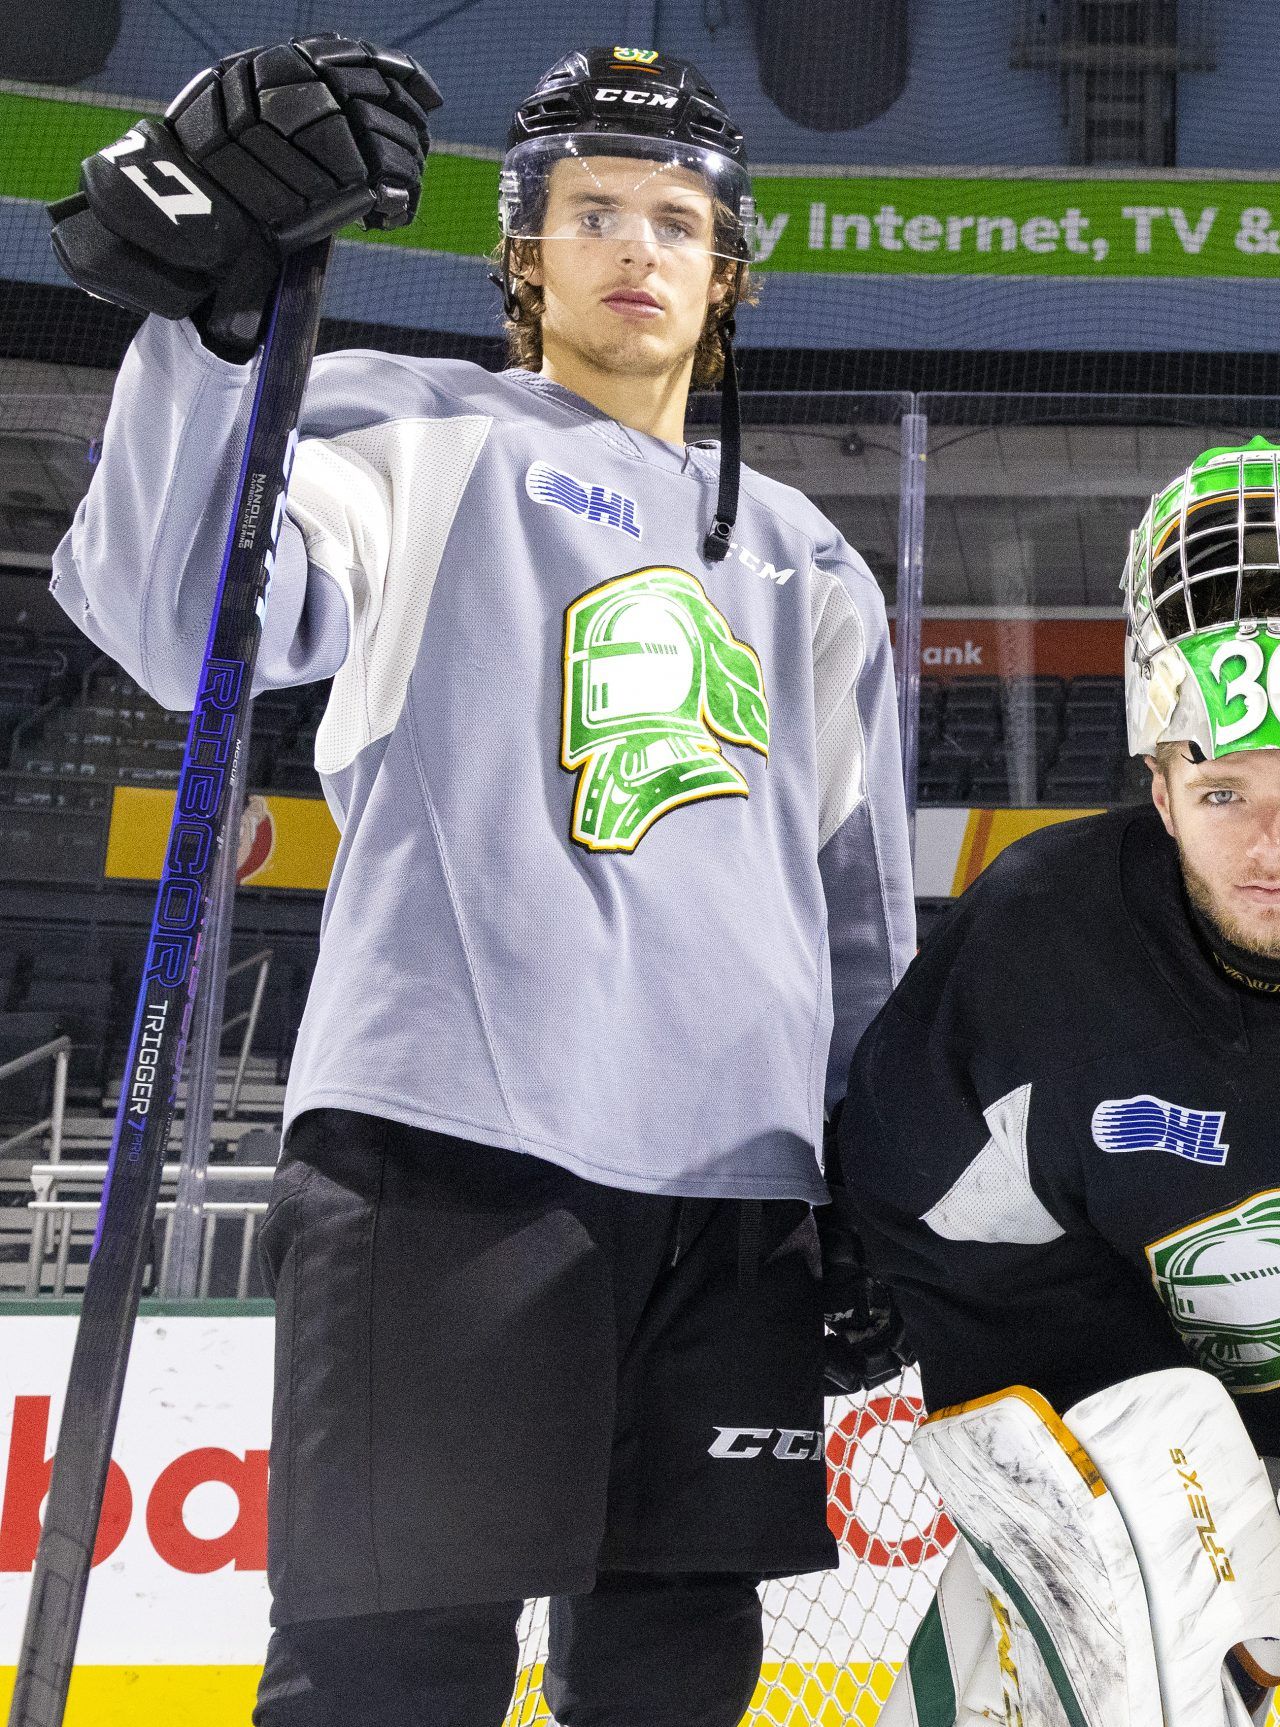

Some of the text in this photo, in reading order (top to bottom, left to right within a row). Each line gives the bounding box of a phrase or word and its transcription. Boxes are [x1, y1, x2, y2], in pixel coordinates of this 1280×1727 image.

[594, 88, 679, 109] CCM
[807, 202, 1110, 262] Internet,
[1121, 206, 1221, 255] TV
[239, 473, 257, 548] CARBON LAYERING
[244, 474, 266, 549] NANOLITE
[144, 657, 246, 989] RIBCOR
[130, 1000, 169, 1115] TRIGGER
[127, 1116, 148, 1132] 7
[707, 1425, 825, 1461] CC
